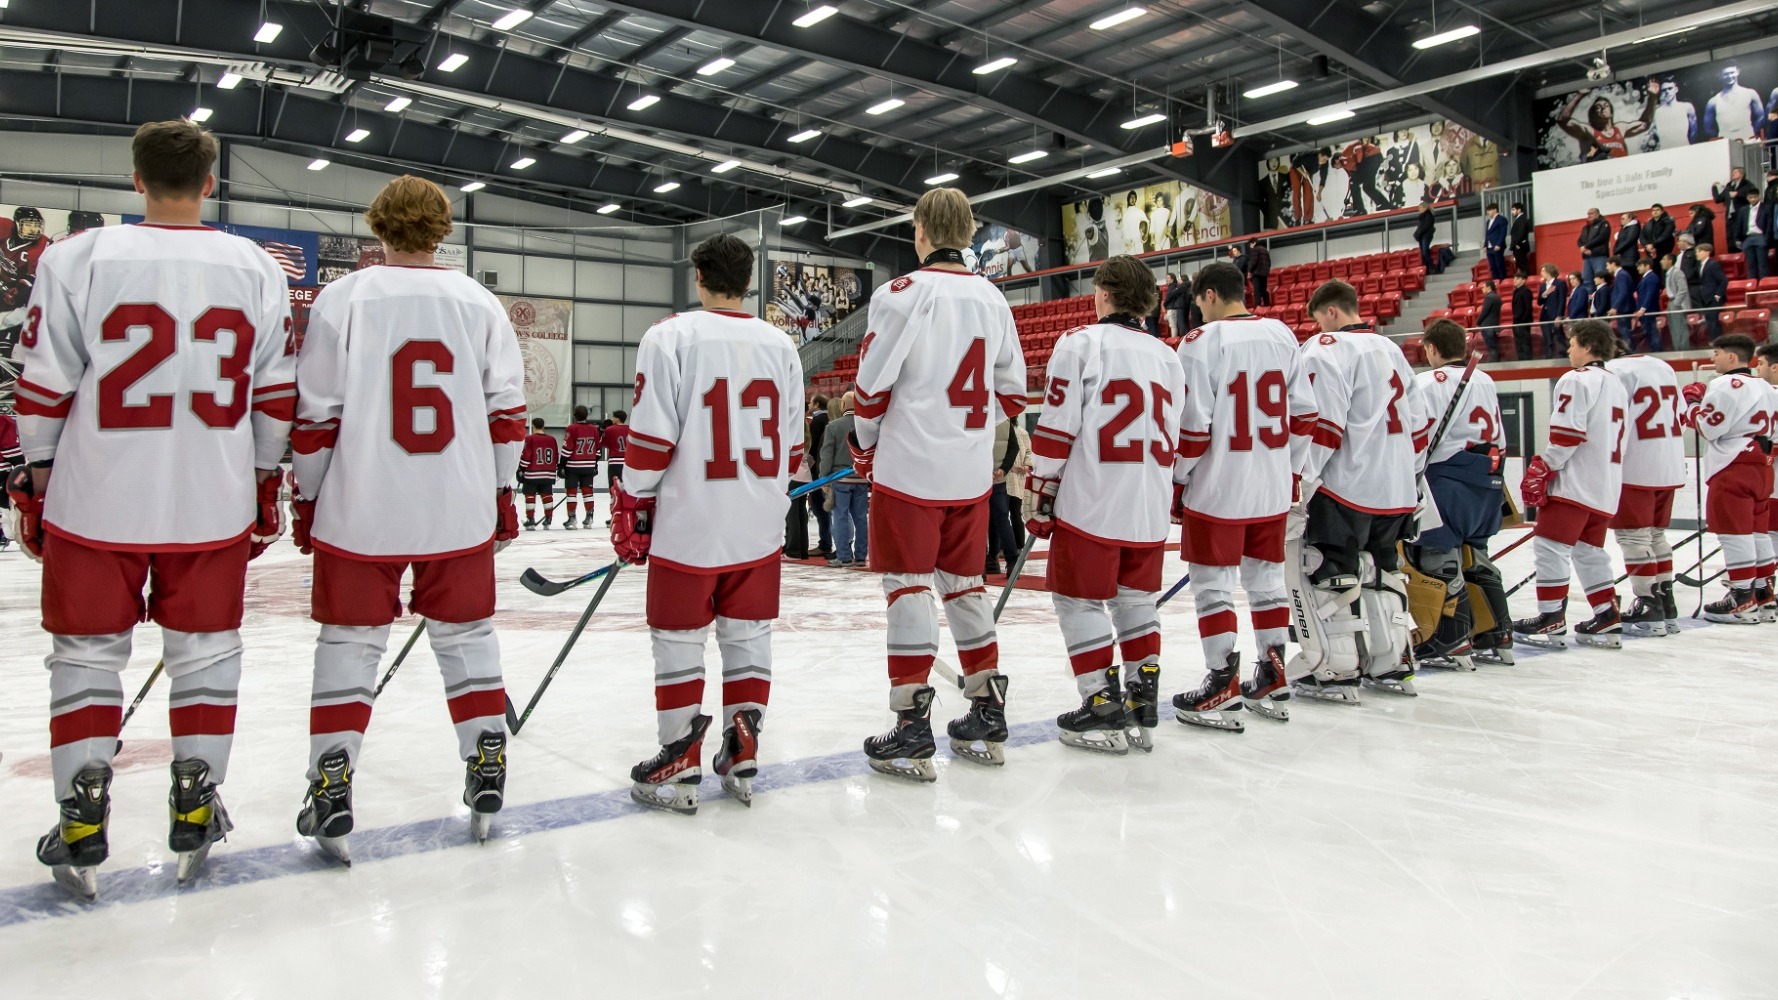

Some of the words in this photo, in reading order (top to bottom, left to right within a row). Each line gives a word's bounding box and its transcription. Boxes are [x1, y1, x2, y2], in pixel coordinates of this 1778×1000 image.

[1645, 167, 1673, 180] Family
[1595, 185, 1636, 199] Spectator
[1638, 182, 1658, 193] Area
[532, 331, 568, 341] COLLEGE
[97, 302, 256, 432] 23
[945, 336, 990, 431] 4
[1043, 375, 1070, 408] 5
[389, 338, 456, 456] 6
[1558, 394, 1572, 413] 7
[1097, 378, 1175, 468] 25
[1226, 369, 1290, 453] 19
[1633, 385, 1683, 440] 27
[1701, 402, 1725, 427] 29
[702, 377, 781, 482] 13
[1610, 407, 1626, 464] 7
[536, 447, 553, 465] 18
[576, 437, 596, 455] 77
[617, 436, 626, 452] 1
[1292, 588, 1310, 639] BAUER
[1537, 620, 1565, 634] CCM
[1271, 652, 1284, 670] CCM
[1196, 689, 1232, 711] CCM
[736, 717, 750, 737] CCM
[645, 757, 689, 784] CCM
